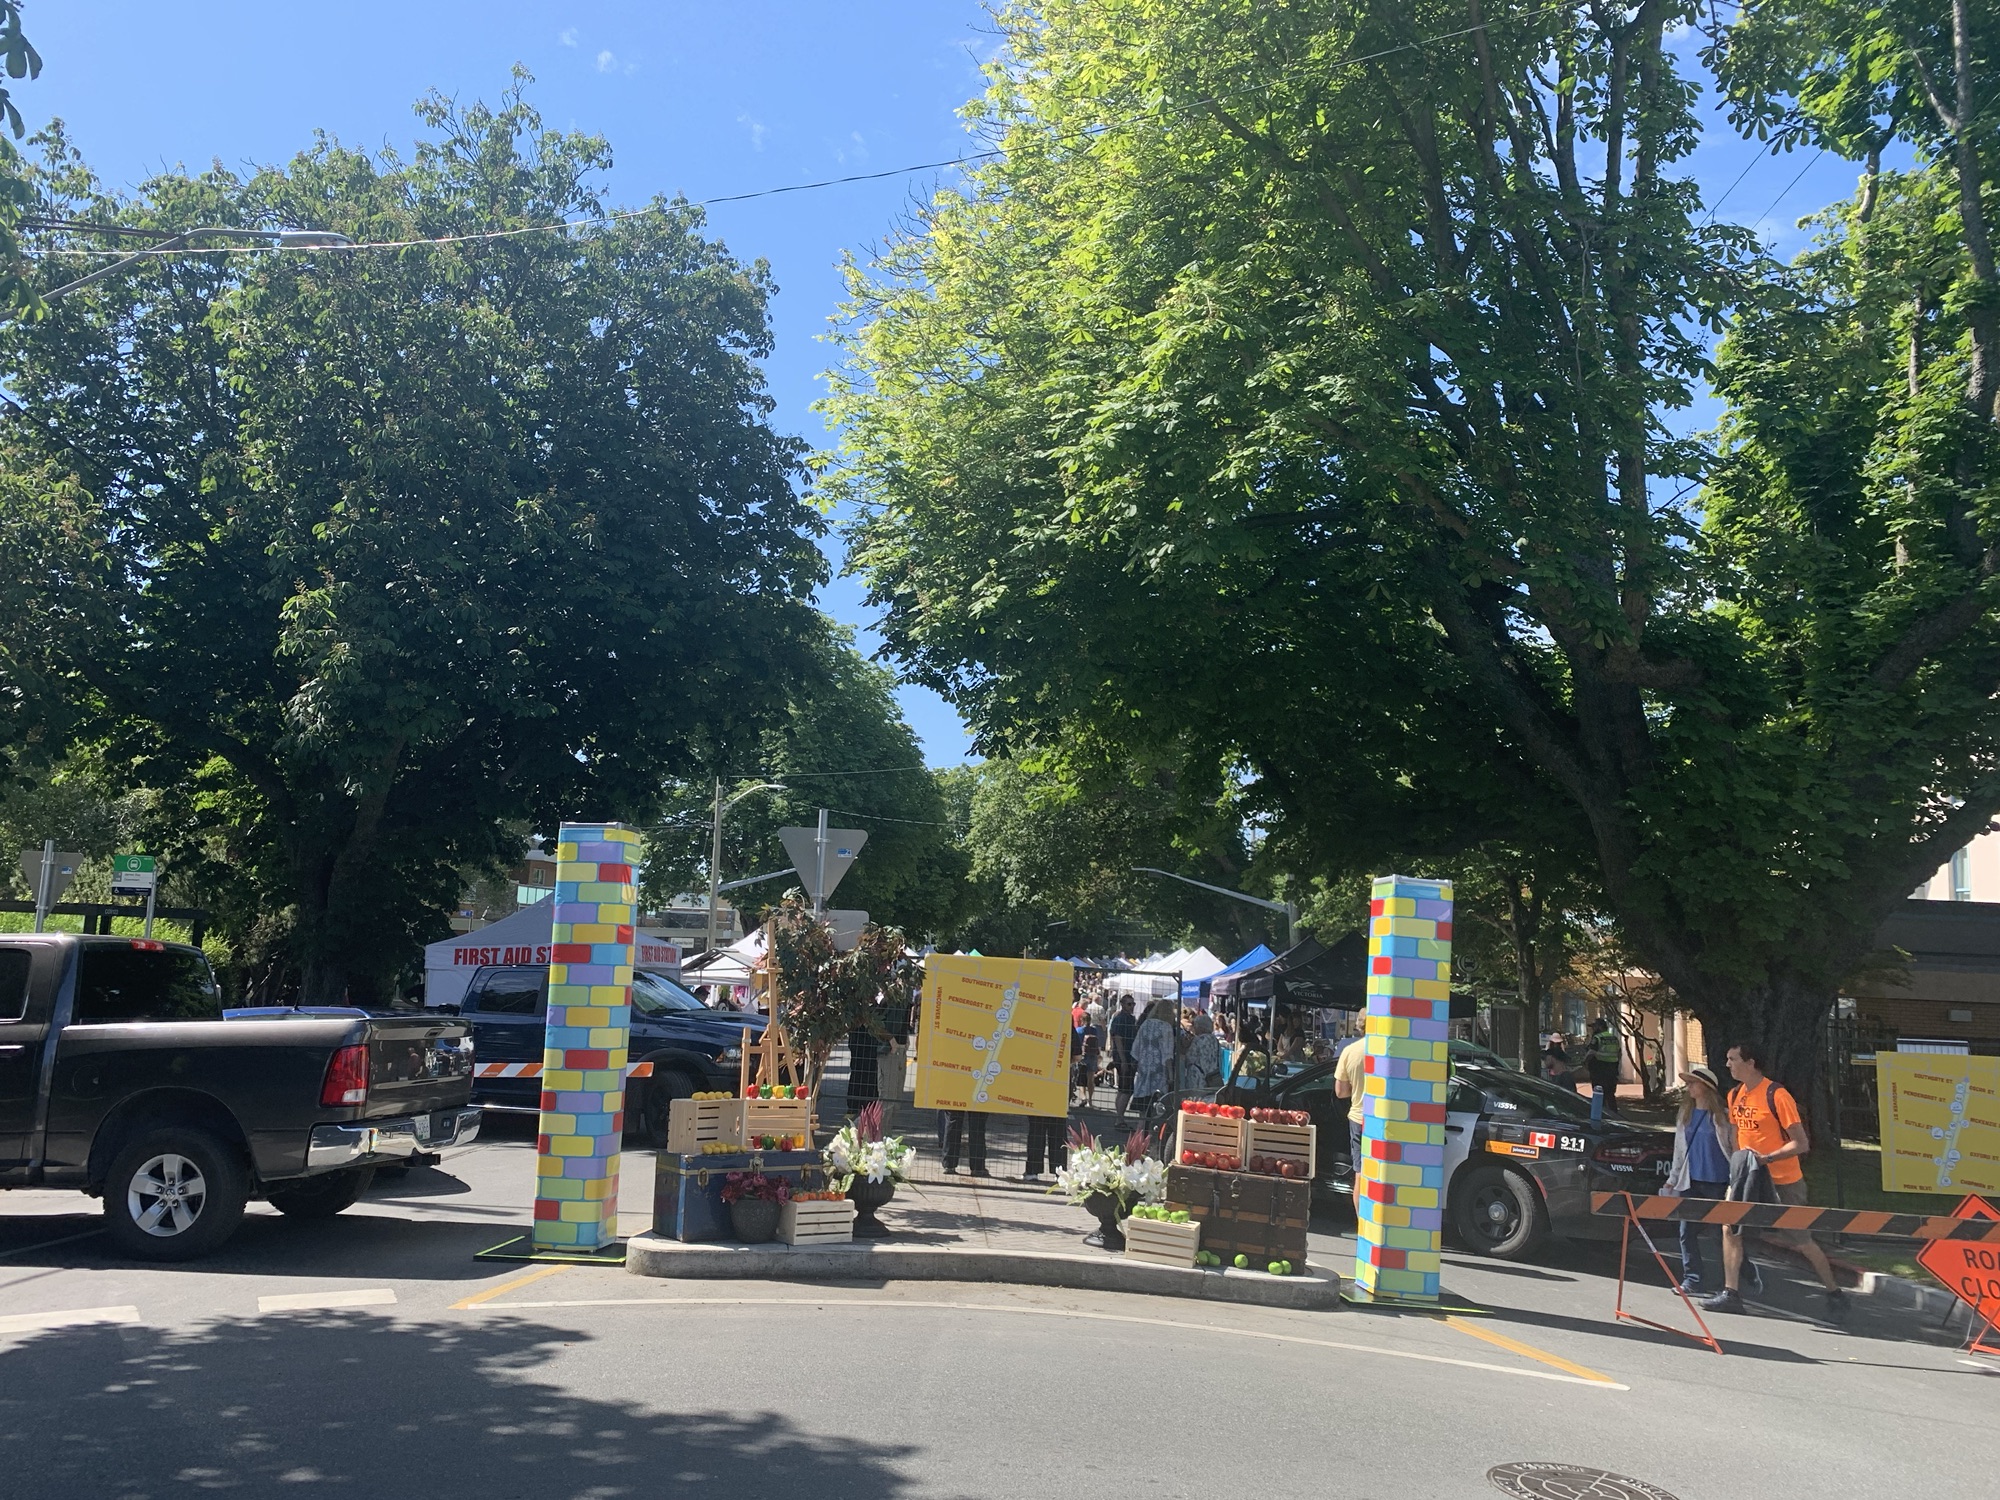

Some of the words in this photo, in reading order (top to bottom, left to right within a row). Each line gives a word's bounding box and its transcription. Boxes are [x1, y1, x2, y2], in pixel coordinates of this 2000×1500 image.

[454, 948, 500, 966] FIRST
[503, 946, 532, 964] AID
[961, 977, 994, 989] SOUTHGATE
[1019, 991, 1036, 1001] OSCAR
[948, 996, 984, 1009] PENDERGAST
[946, 1028, 966, 1038] SUTLEJ
[1016, 1026, 1044, 1038] MCKENZIE
[1059, 1033, 1068, 1058] CHESTER
[932, 1060, 959, 1070] OLIPHANT
[960, 1064, 972, 1072] AVE
[1011, 1064, 1033, 1074] OXFORD
[936, 1099, 951, 1107] PARK
[952, 1100, 967, 1108] BLVD
[997, 1094, 1025, 1106] CHAPMAN
[1963, 1248, 2000, 1271] RO
